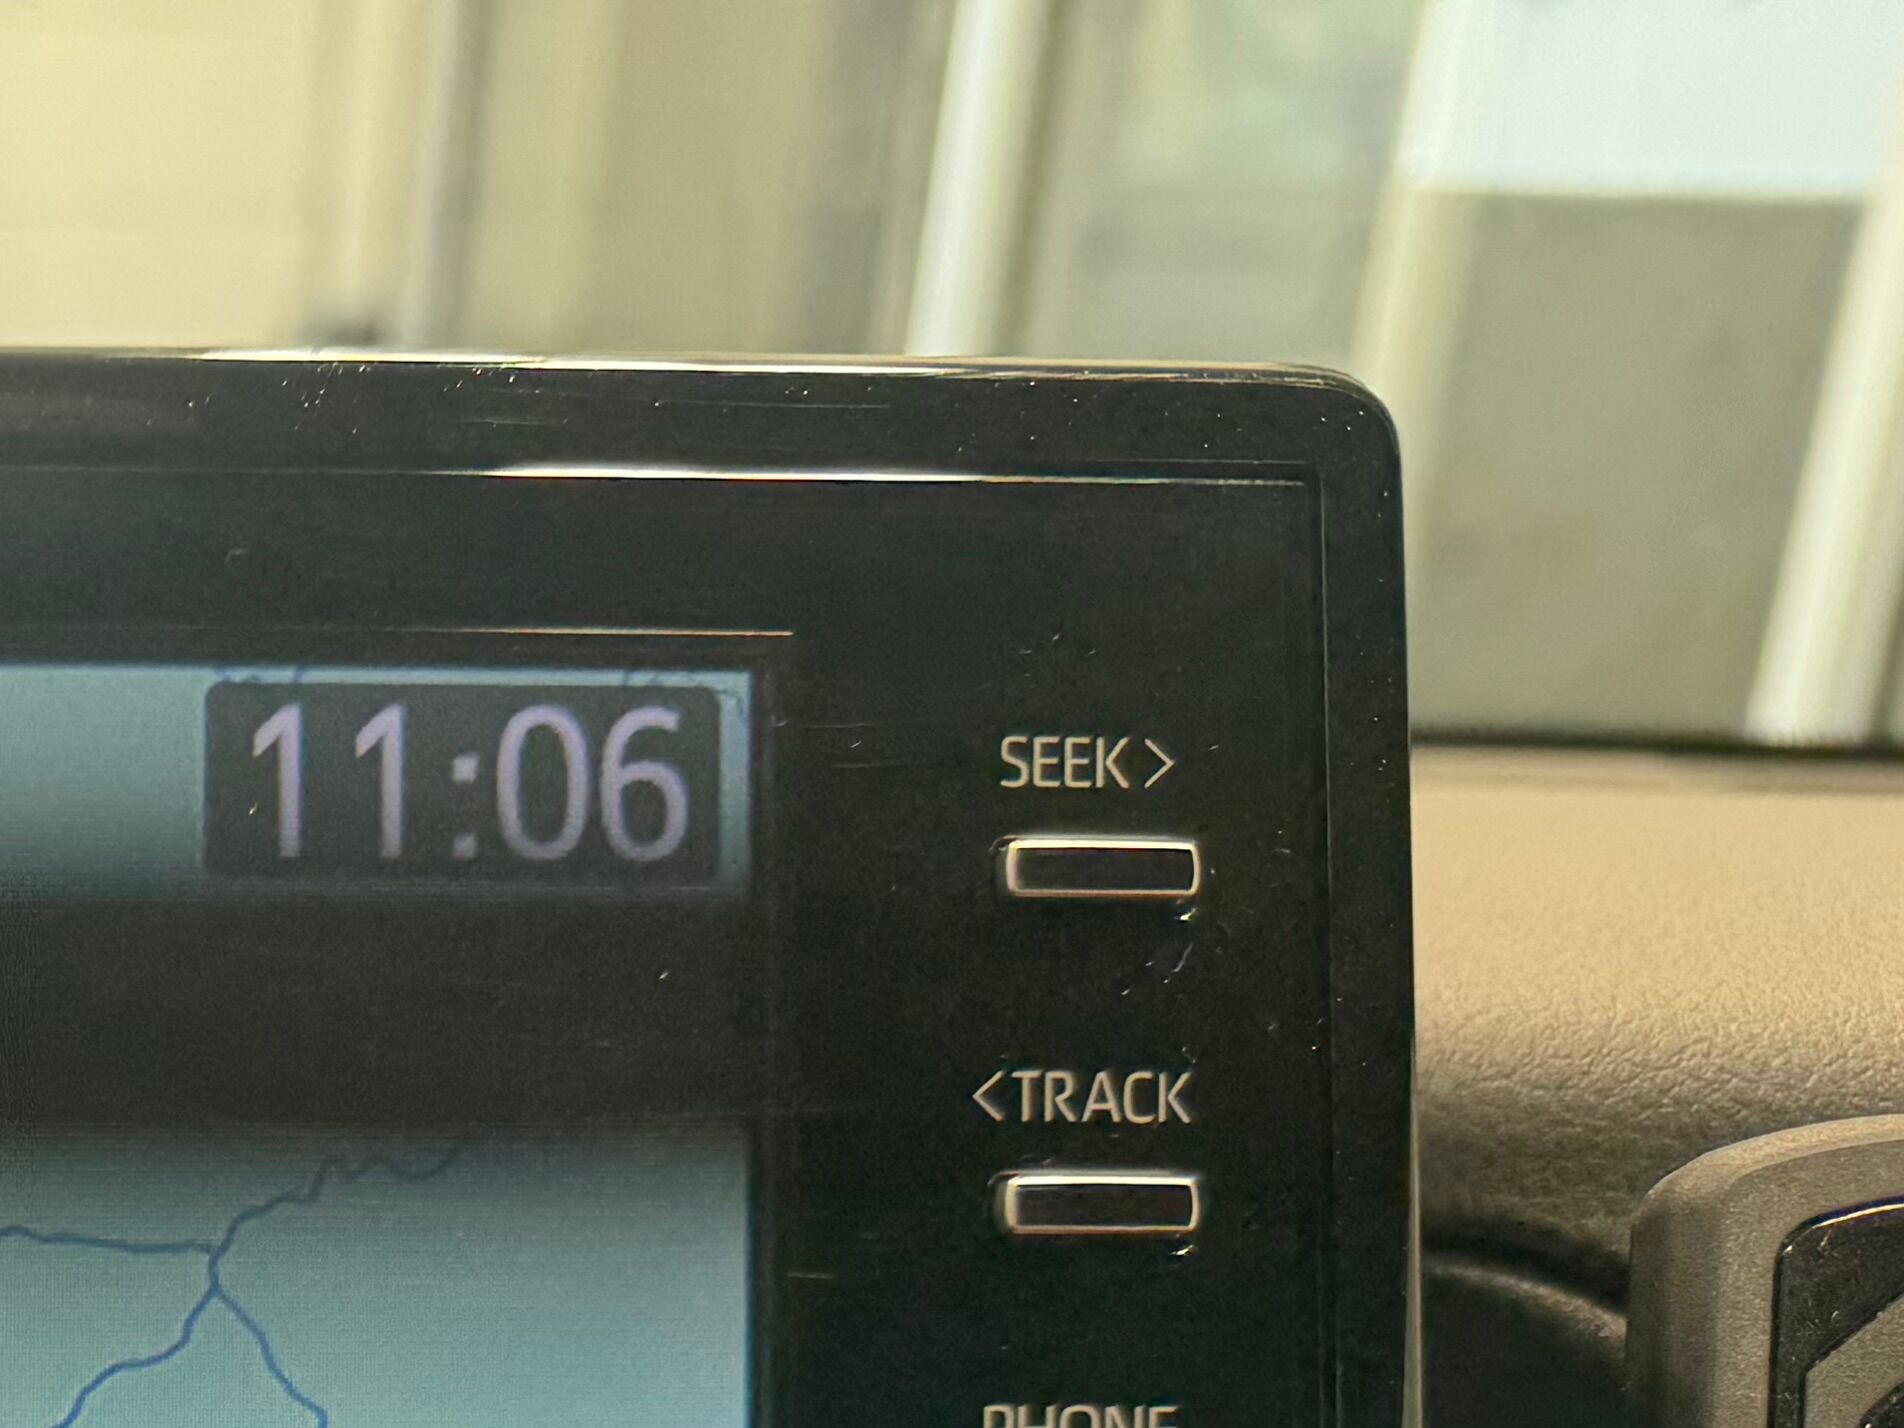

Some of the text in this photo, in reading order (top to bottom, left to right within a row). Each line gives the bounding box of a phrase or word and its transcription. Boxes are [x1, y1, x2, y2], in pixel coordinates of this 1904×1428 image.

[254, 703, 689, 862] 11:06
[1000, 736, 1131, 789] SEEK
[1012, 1070, 1191, 1125] TRACK
